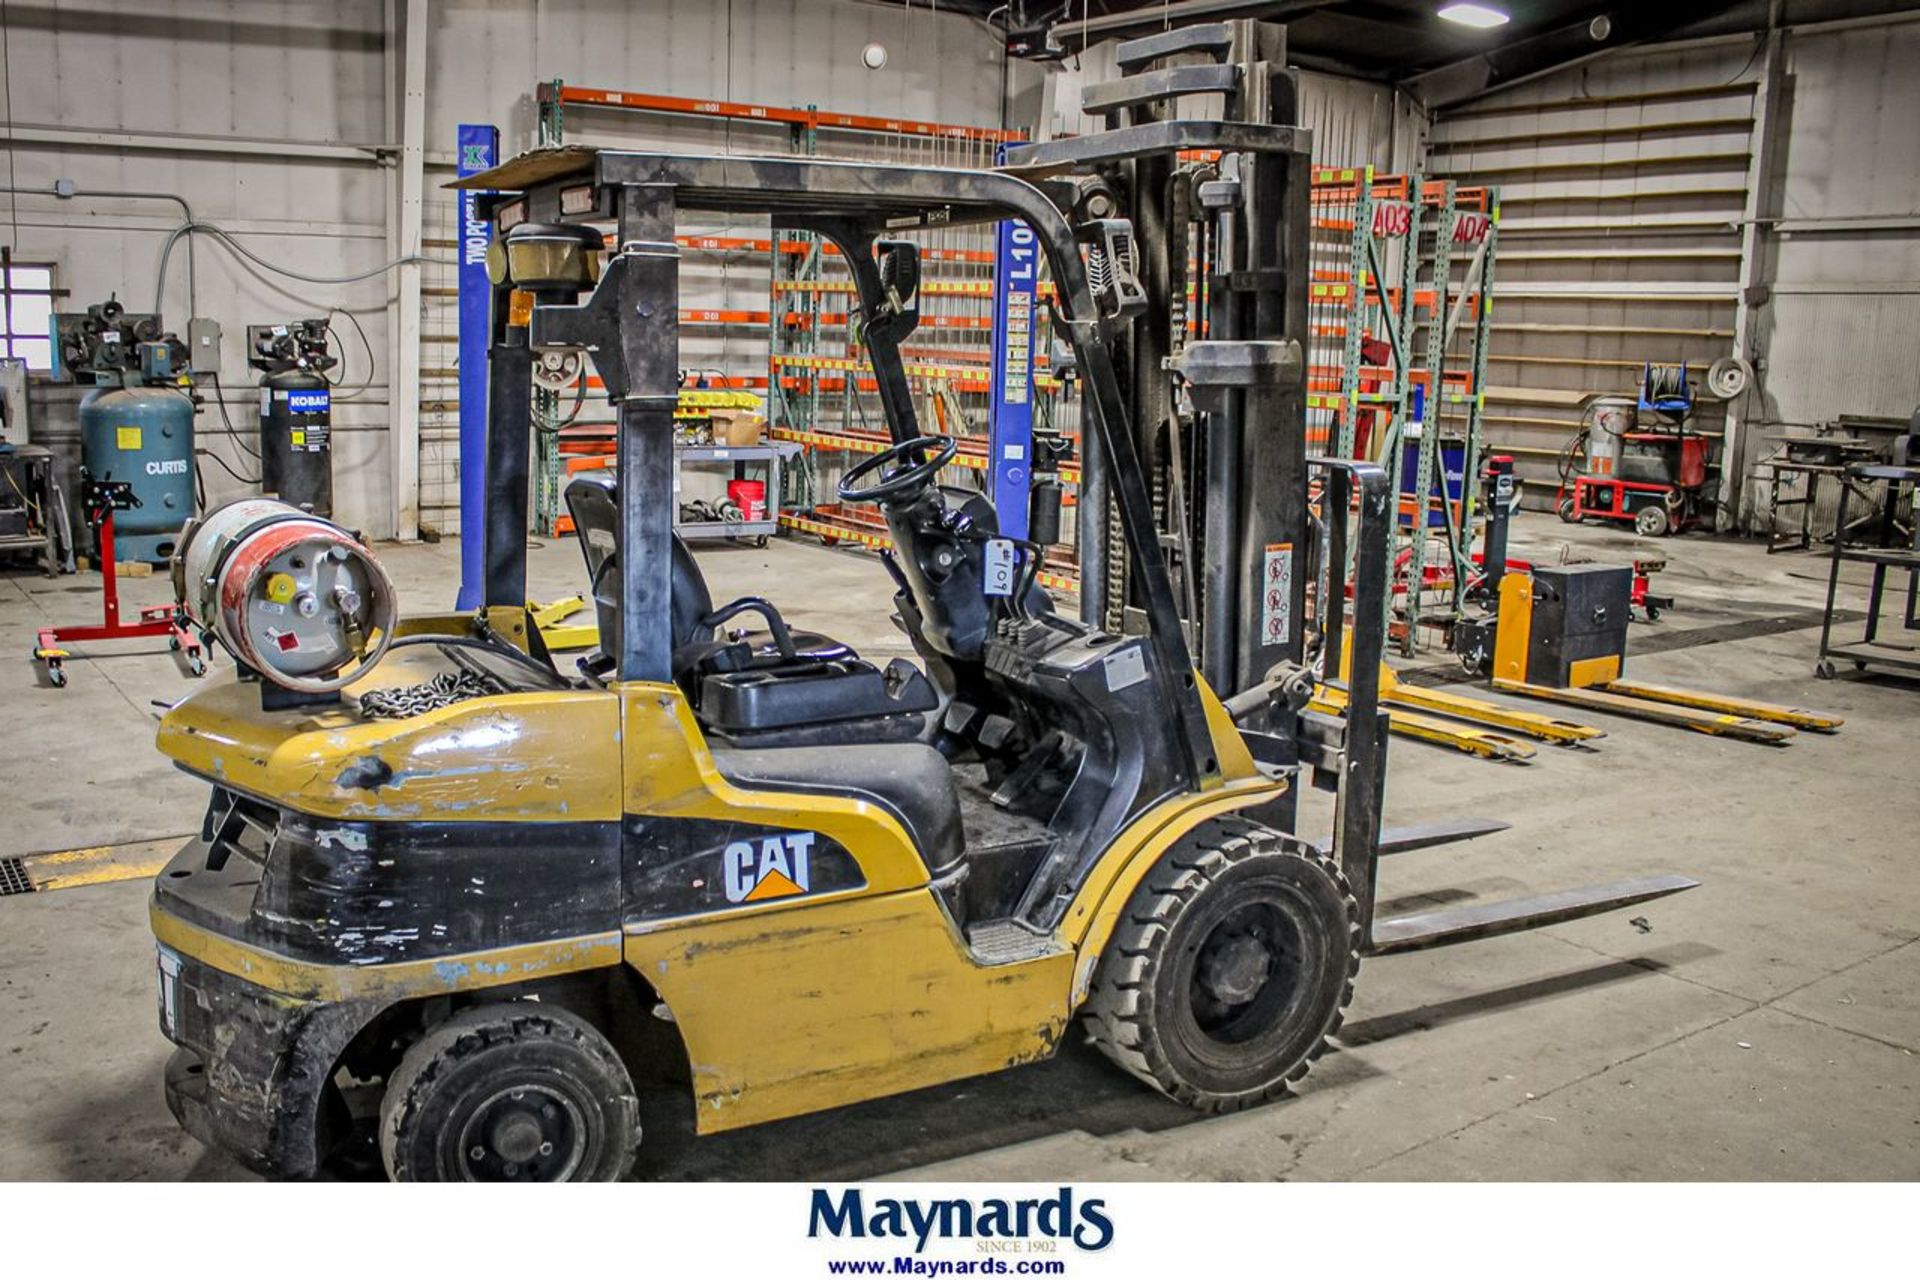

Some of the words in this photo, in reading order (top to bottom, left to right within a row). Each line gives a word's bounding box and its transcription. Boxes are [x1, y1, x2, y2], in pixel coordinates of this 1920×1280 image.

[466, 237, 488, 265] TWO
[290, 395, 328, 407] KOBALT
[145, 460, 188, 475] CURTIS
[724, 831, 815, 904] CAT
